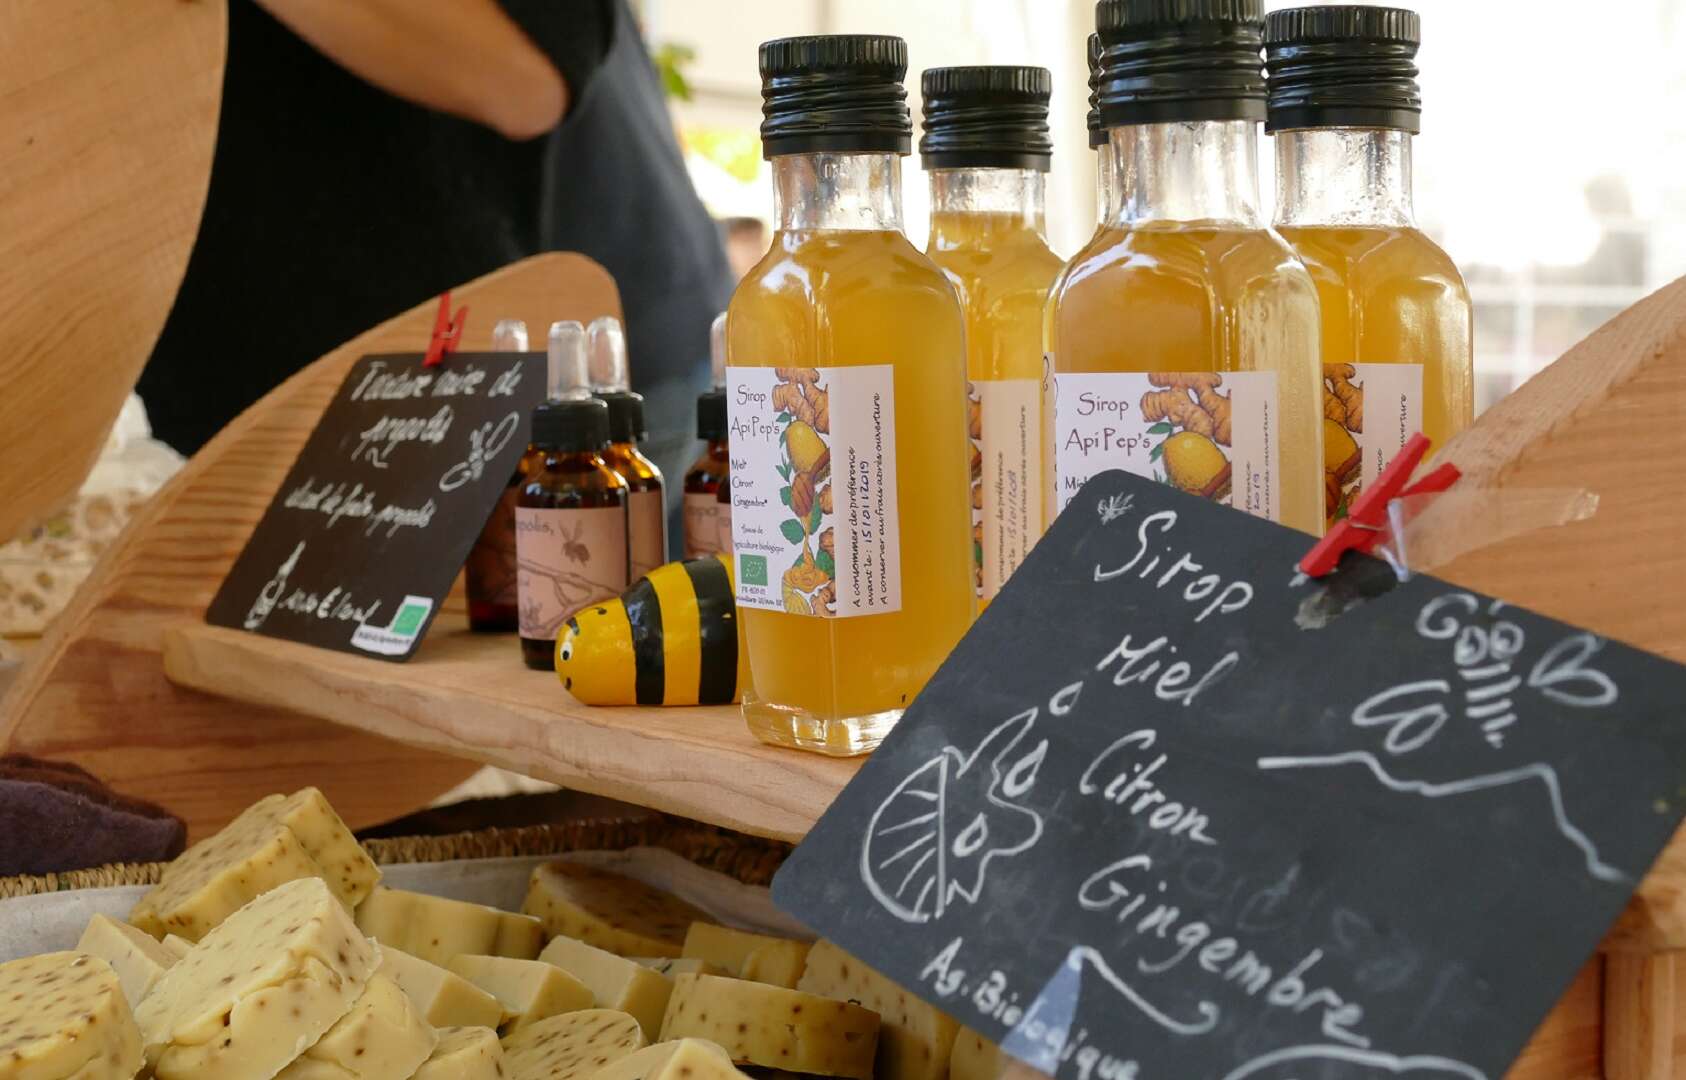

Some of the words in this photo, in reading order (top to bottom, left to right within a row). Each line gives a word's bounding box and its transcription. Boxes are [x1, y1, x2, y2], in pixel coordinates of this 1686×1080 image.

[487, 359, 523, 397] de
[736, 384, 767, 410] Sirop
[873, 392, 881, 451] ouverture
[1077, 392, 1129, 421] Sirop
[847, 446, 859, 509] préférence
[849, 510, 857, 526] de
[875, 488, 884, 515] frais
[879, 517, 885, 536] au
[852, 528, 861, 596] consommer
[879, 538, 887, 593] conserver
[1093, 510, 1254, 622] Sirop
[853, 598, 861, 608] A
[866, 571, 874, 606] avant
[880, 596, 887, 605] A
[1096, 634, 1239, 706] Miel
[1079, 729, 1218, 845] Citron
[1078, 855, 1371, 1048] Gingembre
